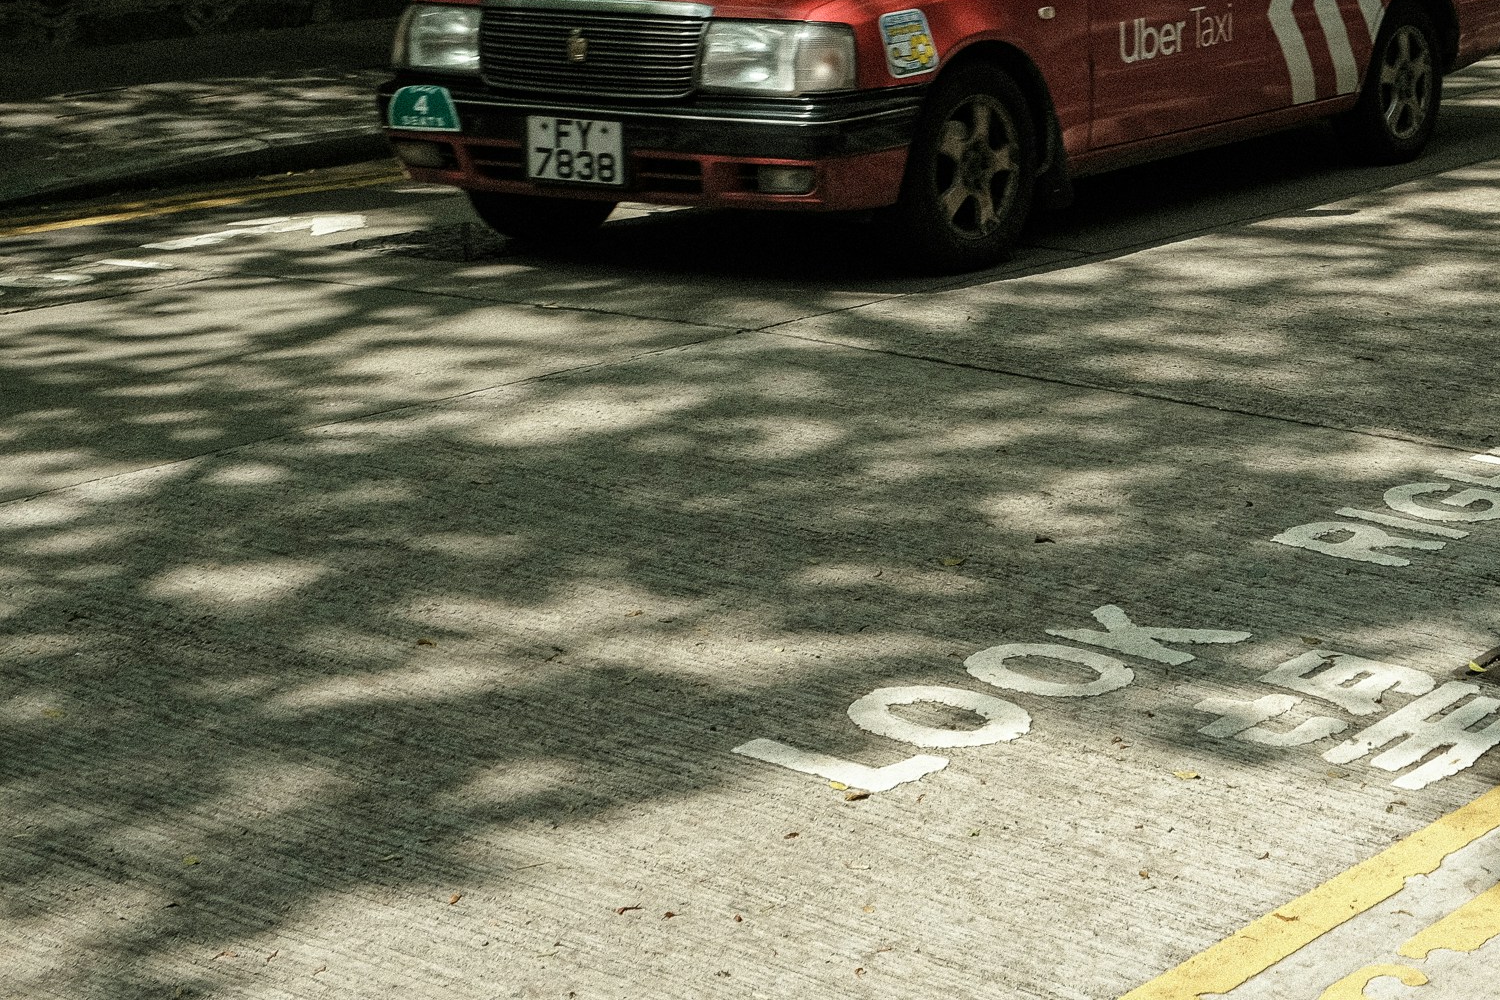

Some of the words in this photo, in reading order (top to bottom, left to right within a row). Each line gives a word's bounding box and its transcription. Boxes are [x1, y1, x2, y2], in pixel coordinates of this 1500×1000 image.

[1119, 17, 1186, 64] Uber
[1188, 2, 1233, 49] Taxi
[413, 95, 428, 115] 4
[555, 119, 594, 150] FY
[535, 147, 615, 182] 7838
[731, 604, 1253, 793] LOOK
